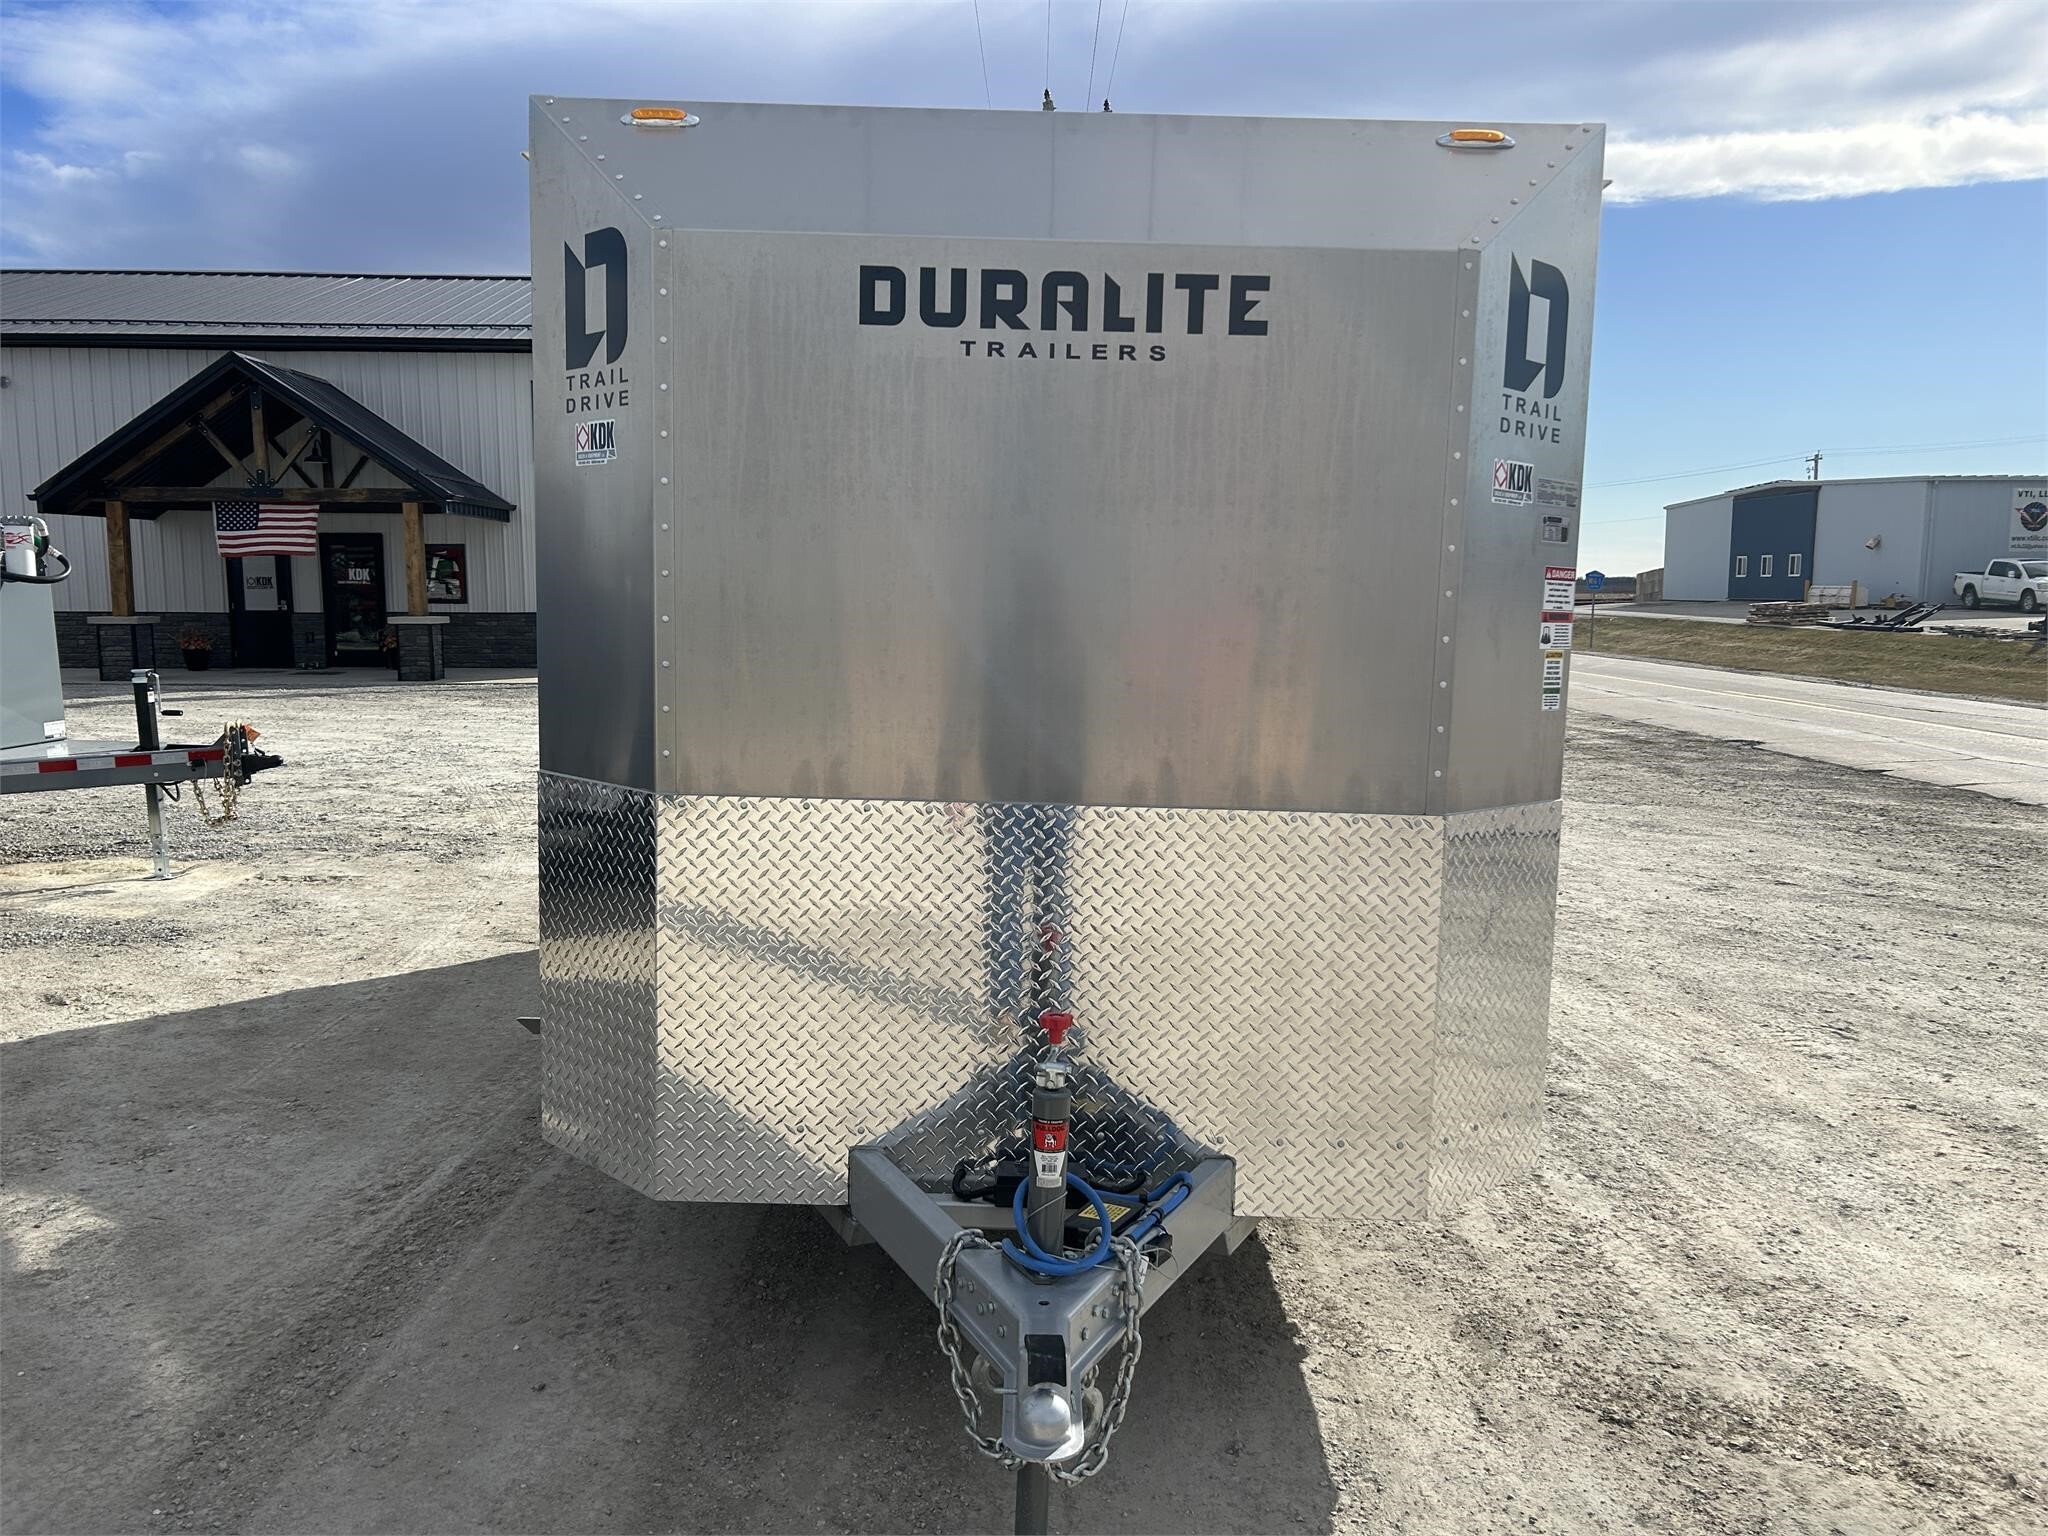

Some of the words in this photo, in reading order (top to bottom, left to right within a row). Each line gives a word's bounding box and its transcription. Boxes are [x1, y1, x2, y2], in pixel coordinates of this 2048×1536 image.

[858, 264, 1271, 337] DURALITE
[959, 339, 1167, 362] TRAILERS
[566, 368, 629, 392] TRAIL
[566, 390, 630, 414] DRIVE
[1502, 393, 1562, 422] TRAIL
[590, 421, 615, 450] KDK
[1500, 417, 1561, 443] DRIVE
[1508, 462, 1533, 492] KDK
[348, 567, 370, 581] KDK
